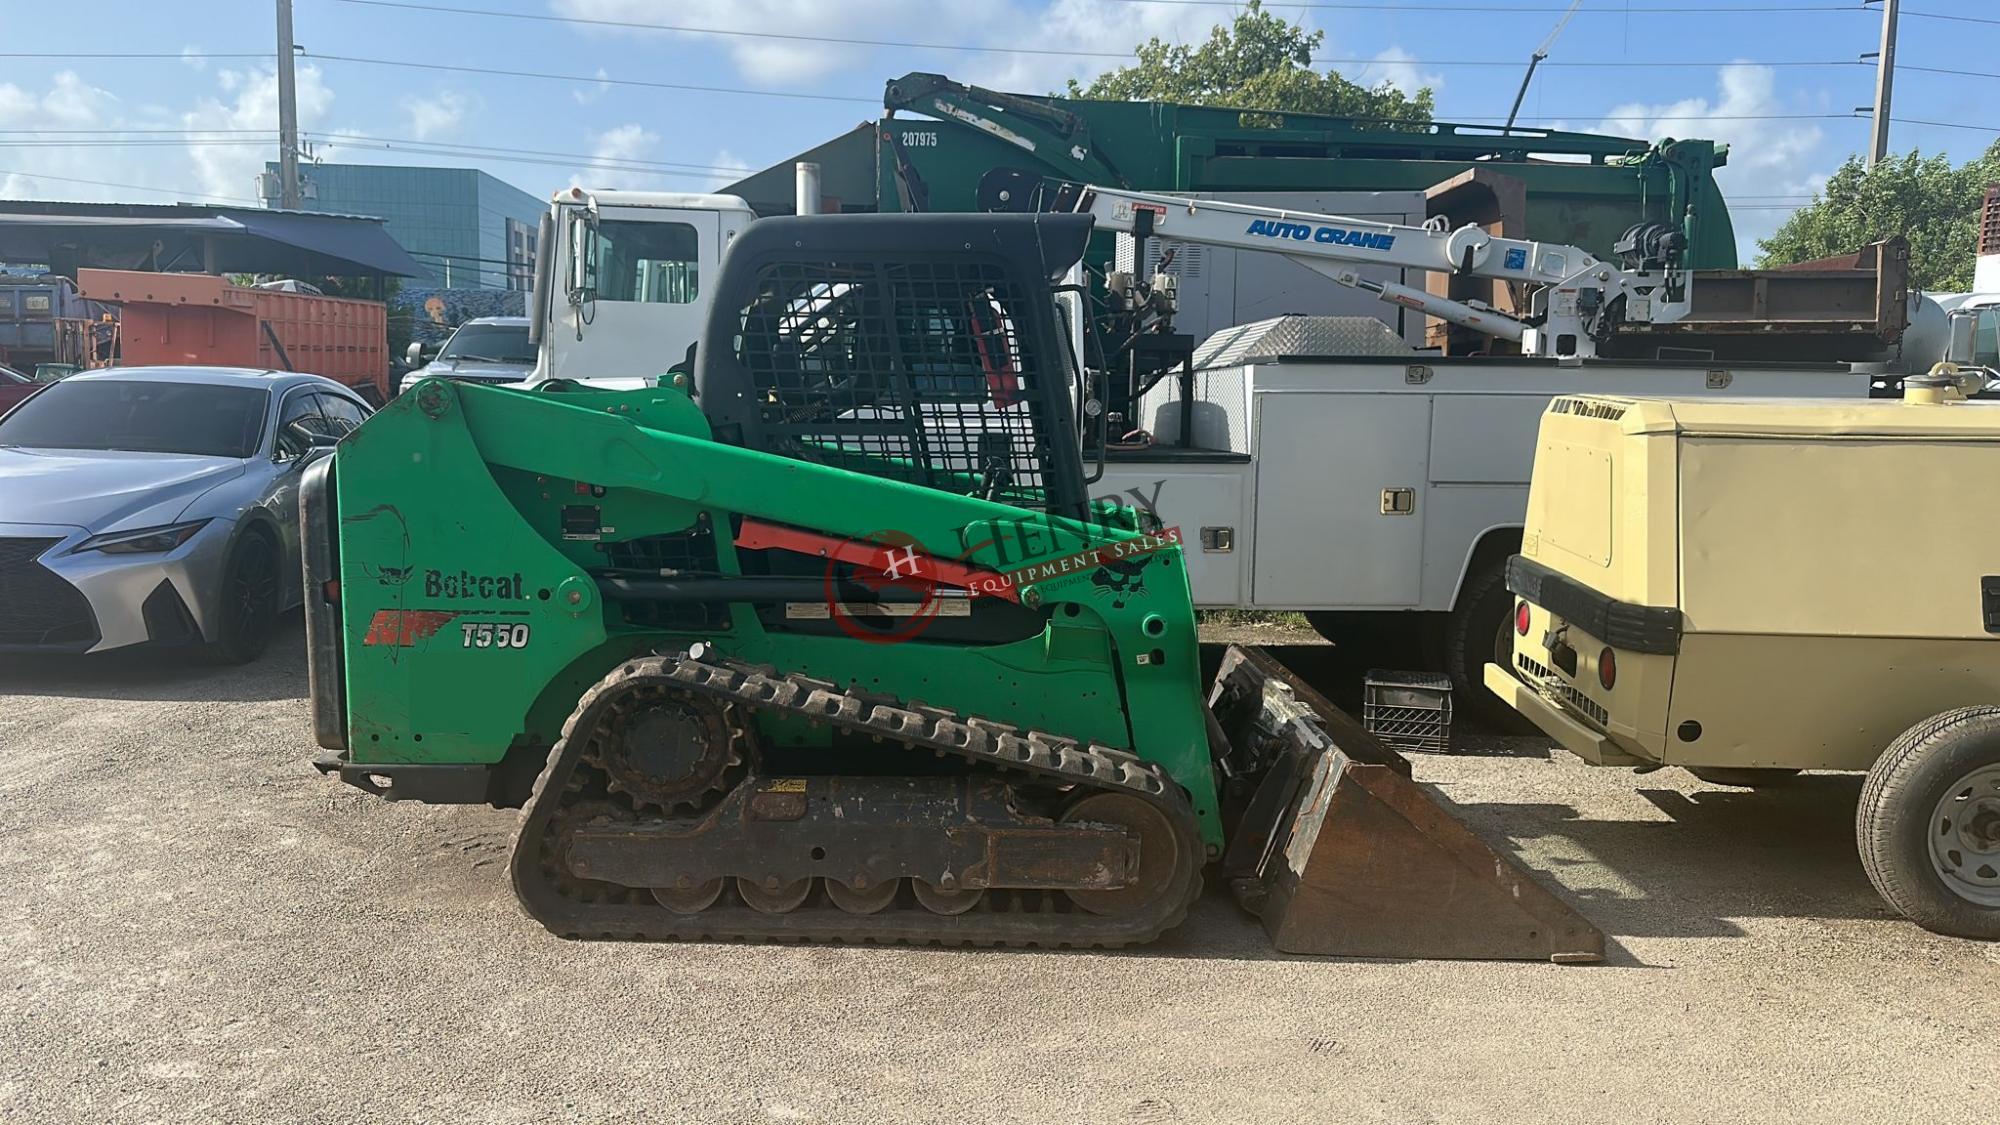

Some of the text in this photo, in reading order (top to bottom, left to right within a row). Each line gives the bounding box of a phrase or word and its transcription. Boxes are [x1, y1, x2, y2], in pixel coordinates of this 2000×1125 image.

[901, 131, 938, 148] 207975
[1246, 218, 1396, 251] AUTO CRANE
[425, 569, 523, 600] Bobcat
[461, 622, 531, 650] T550
